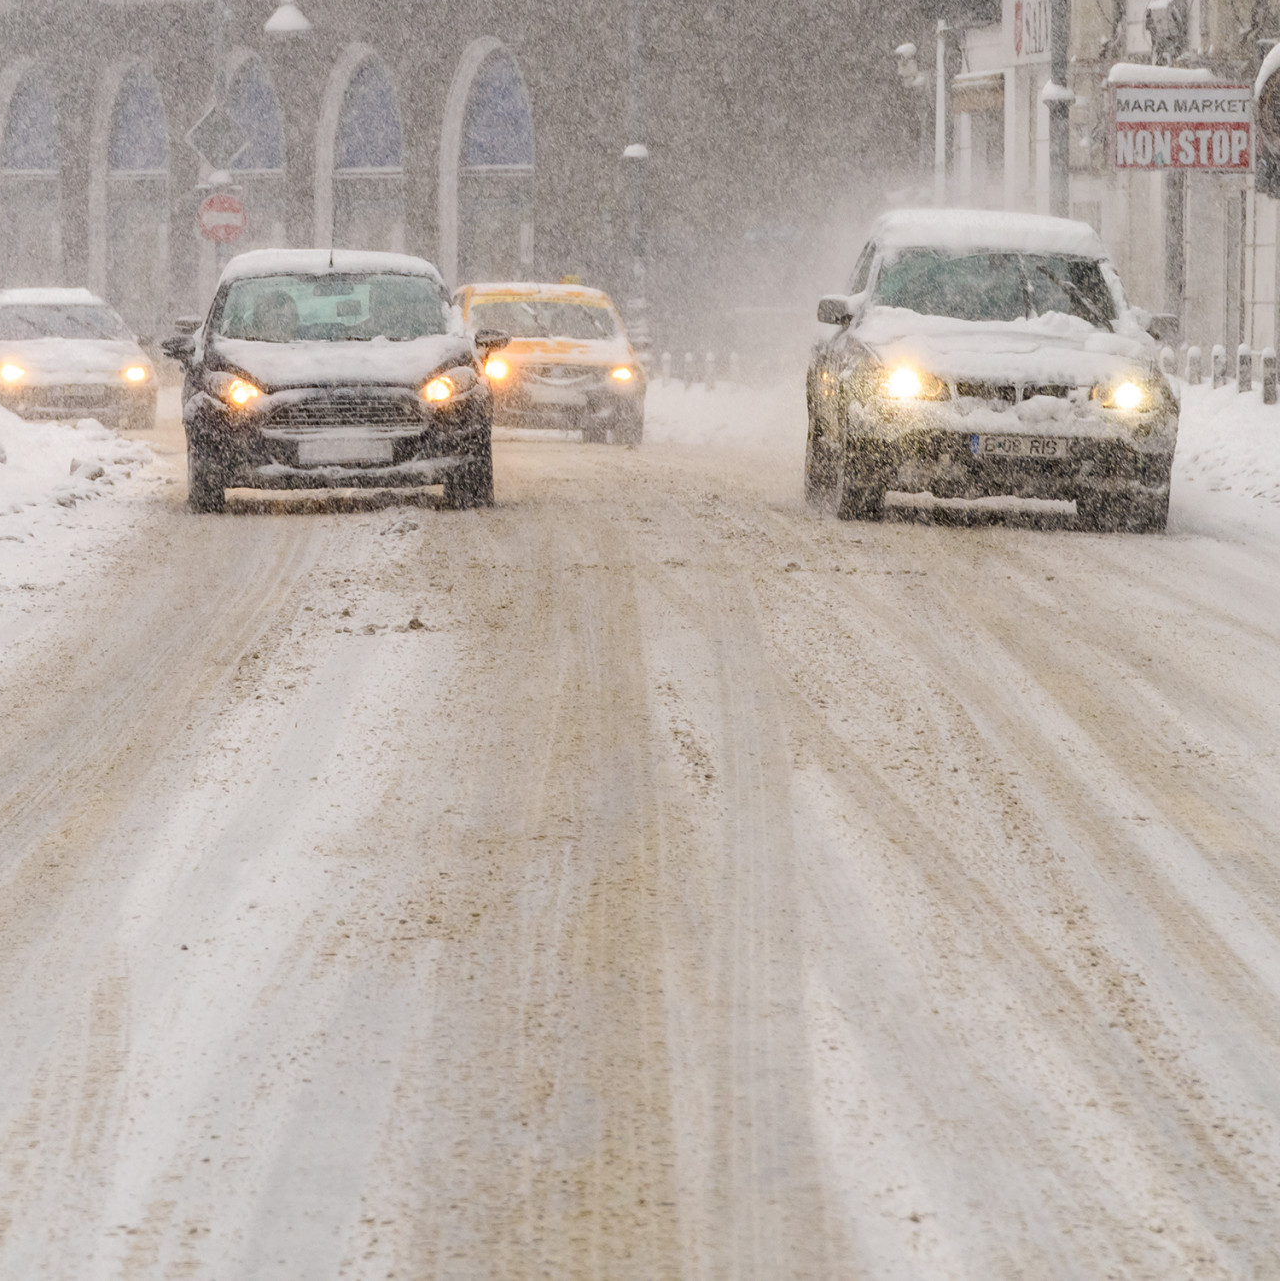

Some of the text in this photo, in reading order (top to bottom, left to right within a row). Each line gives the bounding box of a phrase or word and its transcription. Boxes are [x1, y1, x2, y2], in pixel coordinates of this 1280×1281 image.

[1117, 98, 1250, 113] MARA MARKET
[1117, 129, 1248, 165] NON STOP
